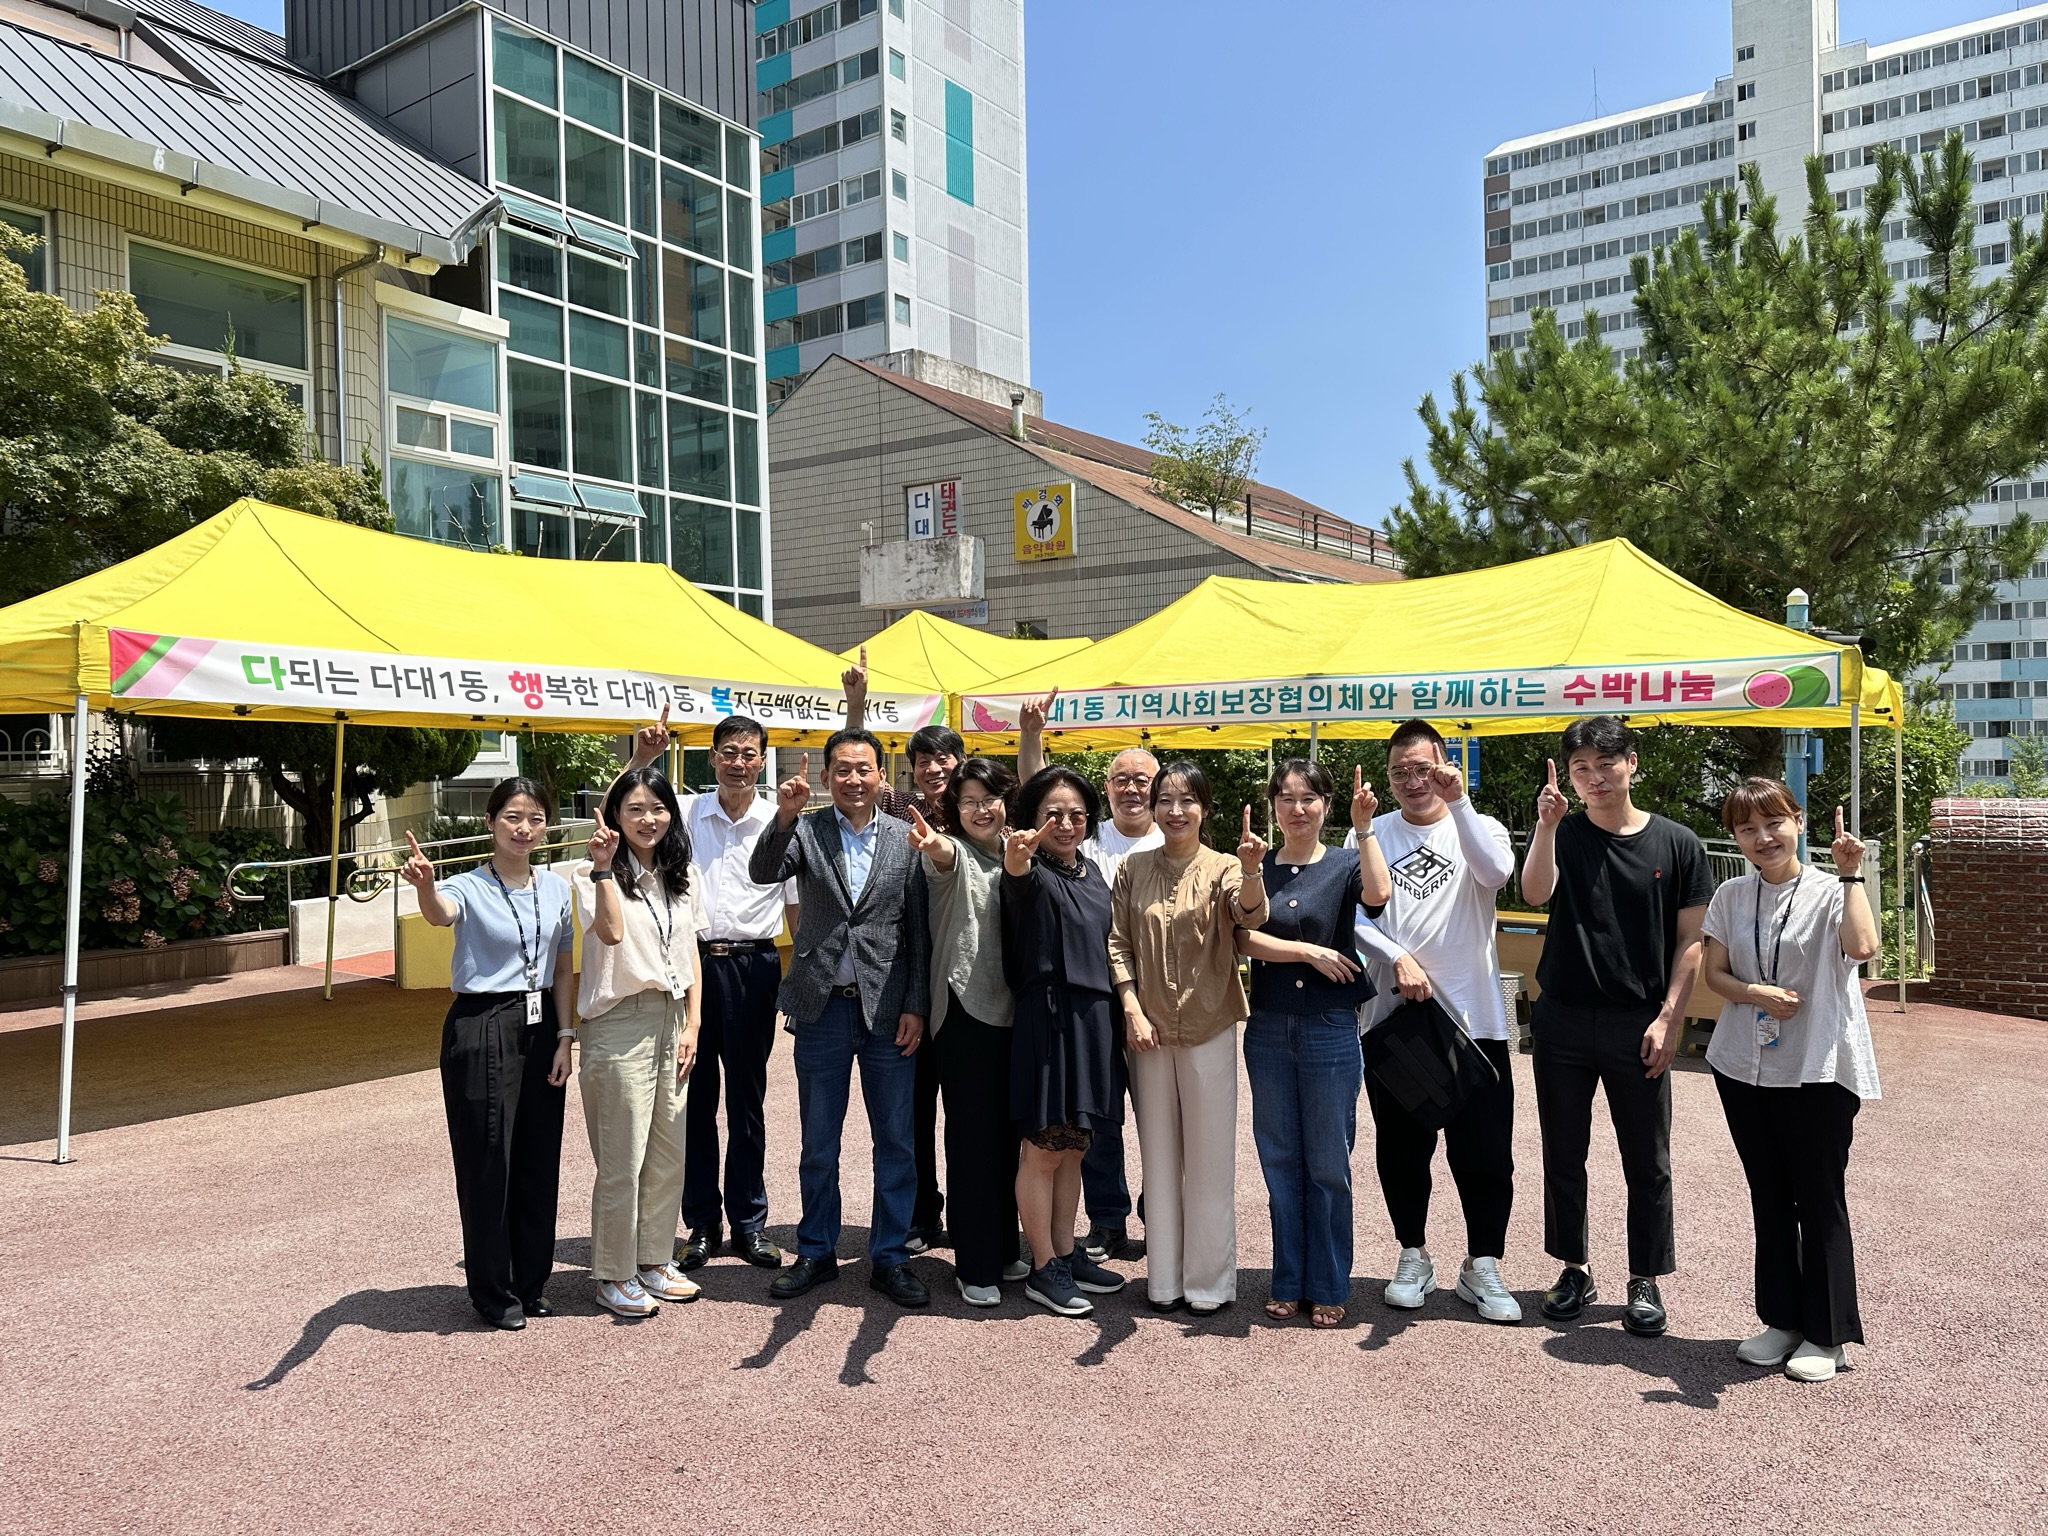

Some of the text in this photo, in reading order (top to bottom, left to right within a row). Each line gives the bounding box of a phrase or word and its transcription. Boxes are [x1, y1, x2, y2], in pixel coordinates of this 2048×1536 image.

[940, 481, 957, 536] 태권도
[1022, 539, 1066, 555] 음악학원
[239, 654, 360, 697] 다되는
[370, 666, 501, 704] 다대1동,
[507, 669, 599, 711] 행복한
[608, 679, 705, 715] 다대1동,
[711, 684, 832, 722] 복지공백없는
[1115, 682, 1398, 719] 지역사회보장협의체와
[1410, 675, 1547, 711] 함께하는
[1562, 668, 1717, 706] 수박나눔
